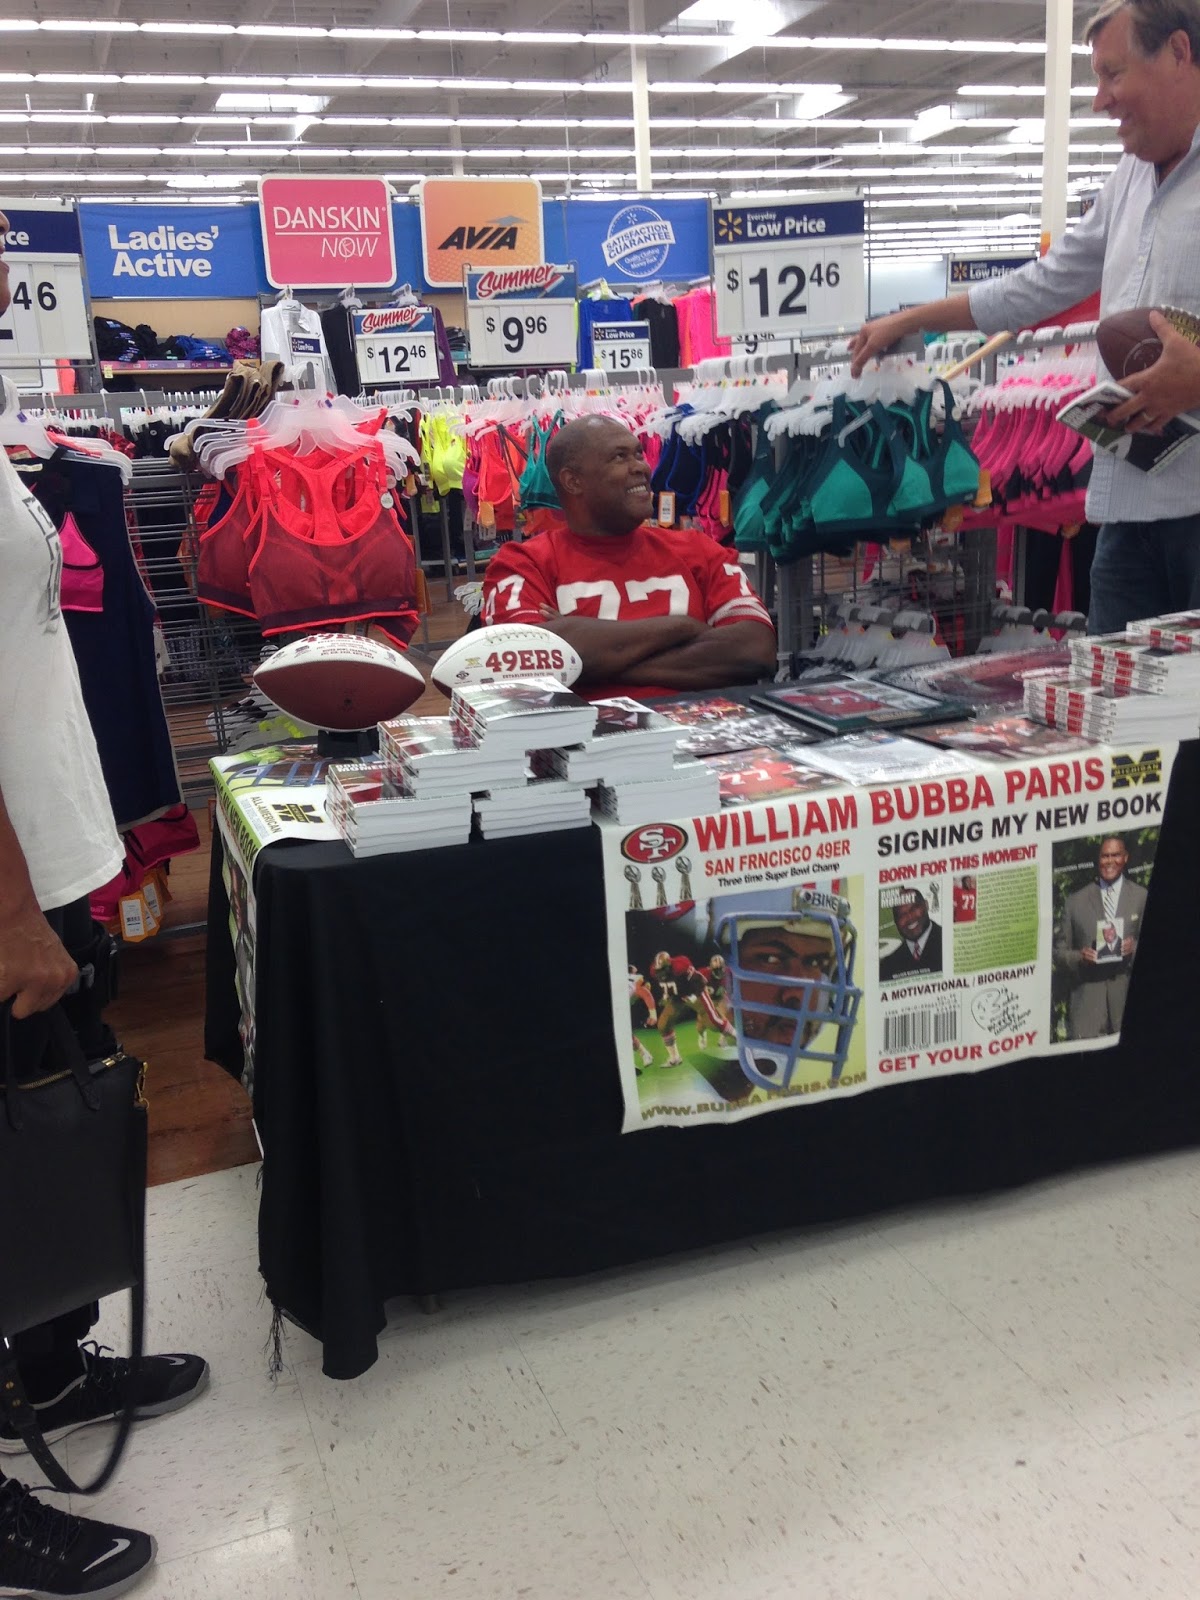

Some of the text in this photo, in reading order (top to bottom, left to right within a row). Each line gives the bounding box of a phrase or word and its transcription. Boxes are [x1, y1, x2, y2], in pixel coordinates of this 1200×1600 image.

[273, 206, 381, 231] DANSKIN
[746, 215, 826, 237] Low Price
[321, 236, 379, 260] NOW
[438, 226, 519, 250] AVIA
[606, 224, 668, 251] SATISFACTION
[609, 231, 671, 259] GUARANTEE
[112, 252, 212, 277] Active
[478, 266, 554, 298] Summer
[363, 308, 416, 333] Summer
[556, 574, 691, 621] 77
[485, 649, 565, 673] 49ERS
[693, 796, 858, 852] WILLIAM
[869, 775, 995, 826] BUBBA
[1004, 757, 1105, 805] PARIS
[877, 791, 1162, 858] SIGNING MY NEW BOOK
[705, 838, 851, 878] SAN FRNCISCO 49ER
[879, 863, 918, 884] BORN
[920, 859, 948, 877] FOR
[949, 850, 980, 872] THIS
[981, 843, 1038, 867] MOMENT
[718, 861, 840, 888] Three time Super Bowl Champ
[880, 991, 889, 1003] A
[891, 977, 970, 1000] MOTIVATIONAL
[977, 964, 1037, 985] BIOGRAPHY
[878, 1054, 920, 1075] GET
[926, 1044, 983, 1068] YOUR
[988, 1030, 1038, 1056] COPY
